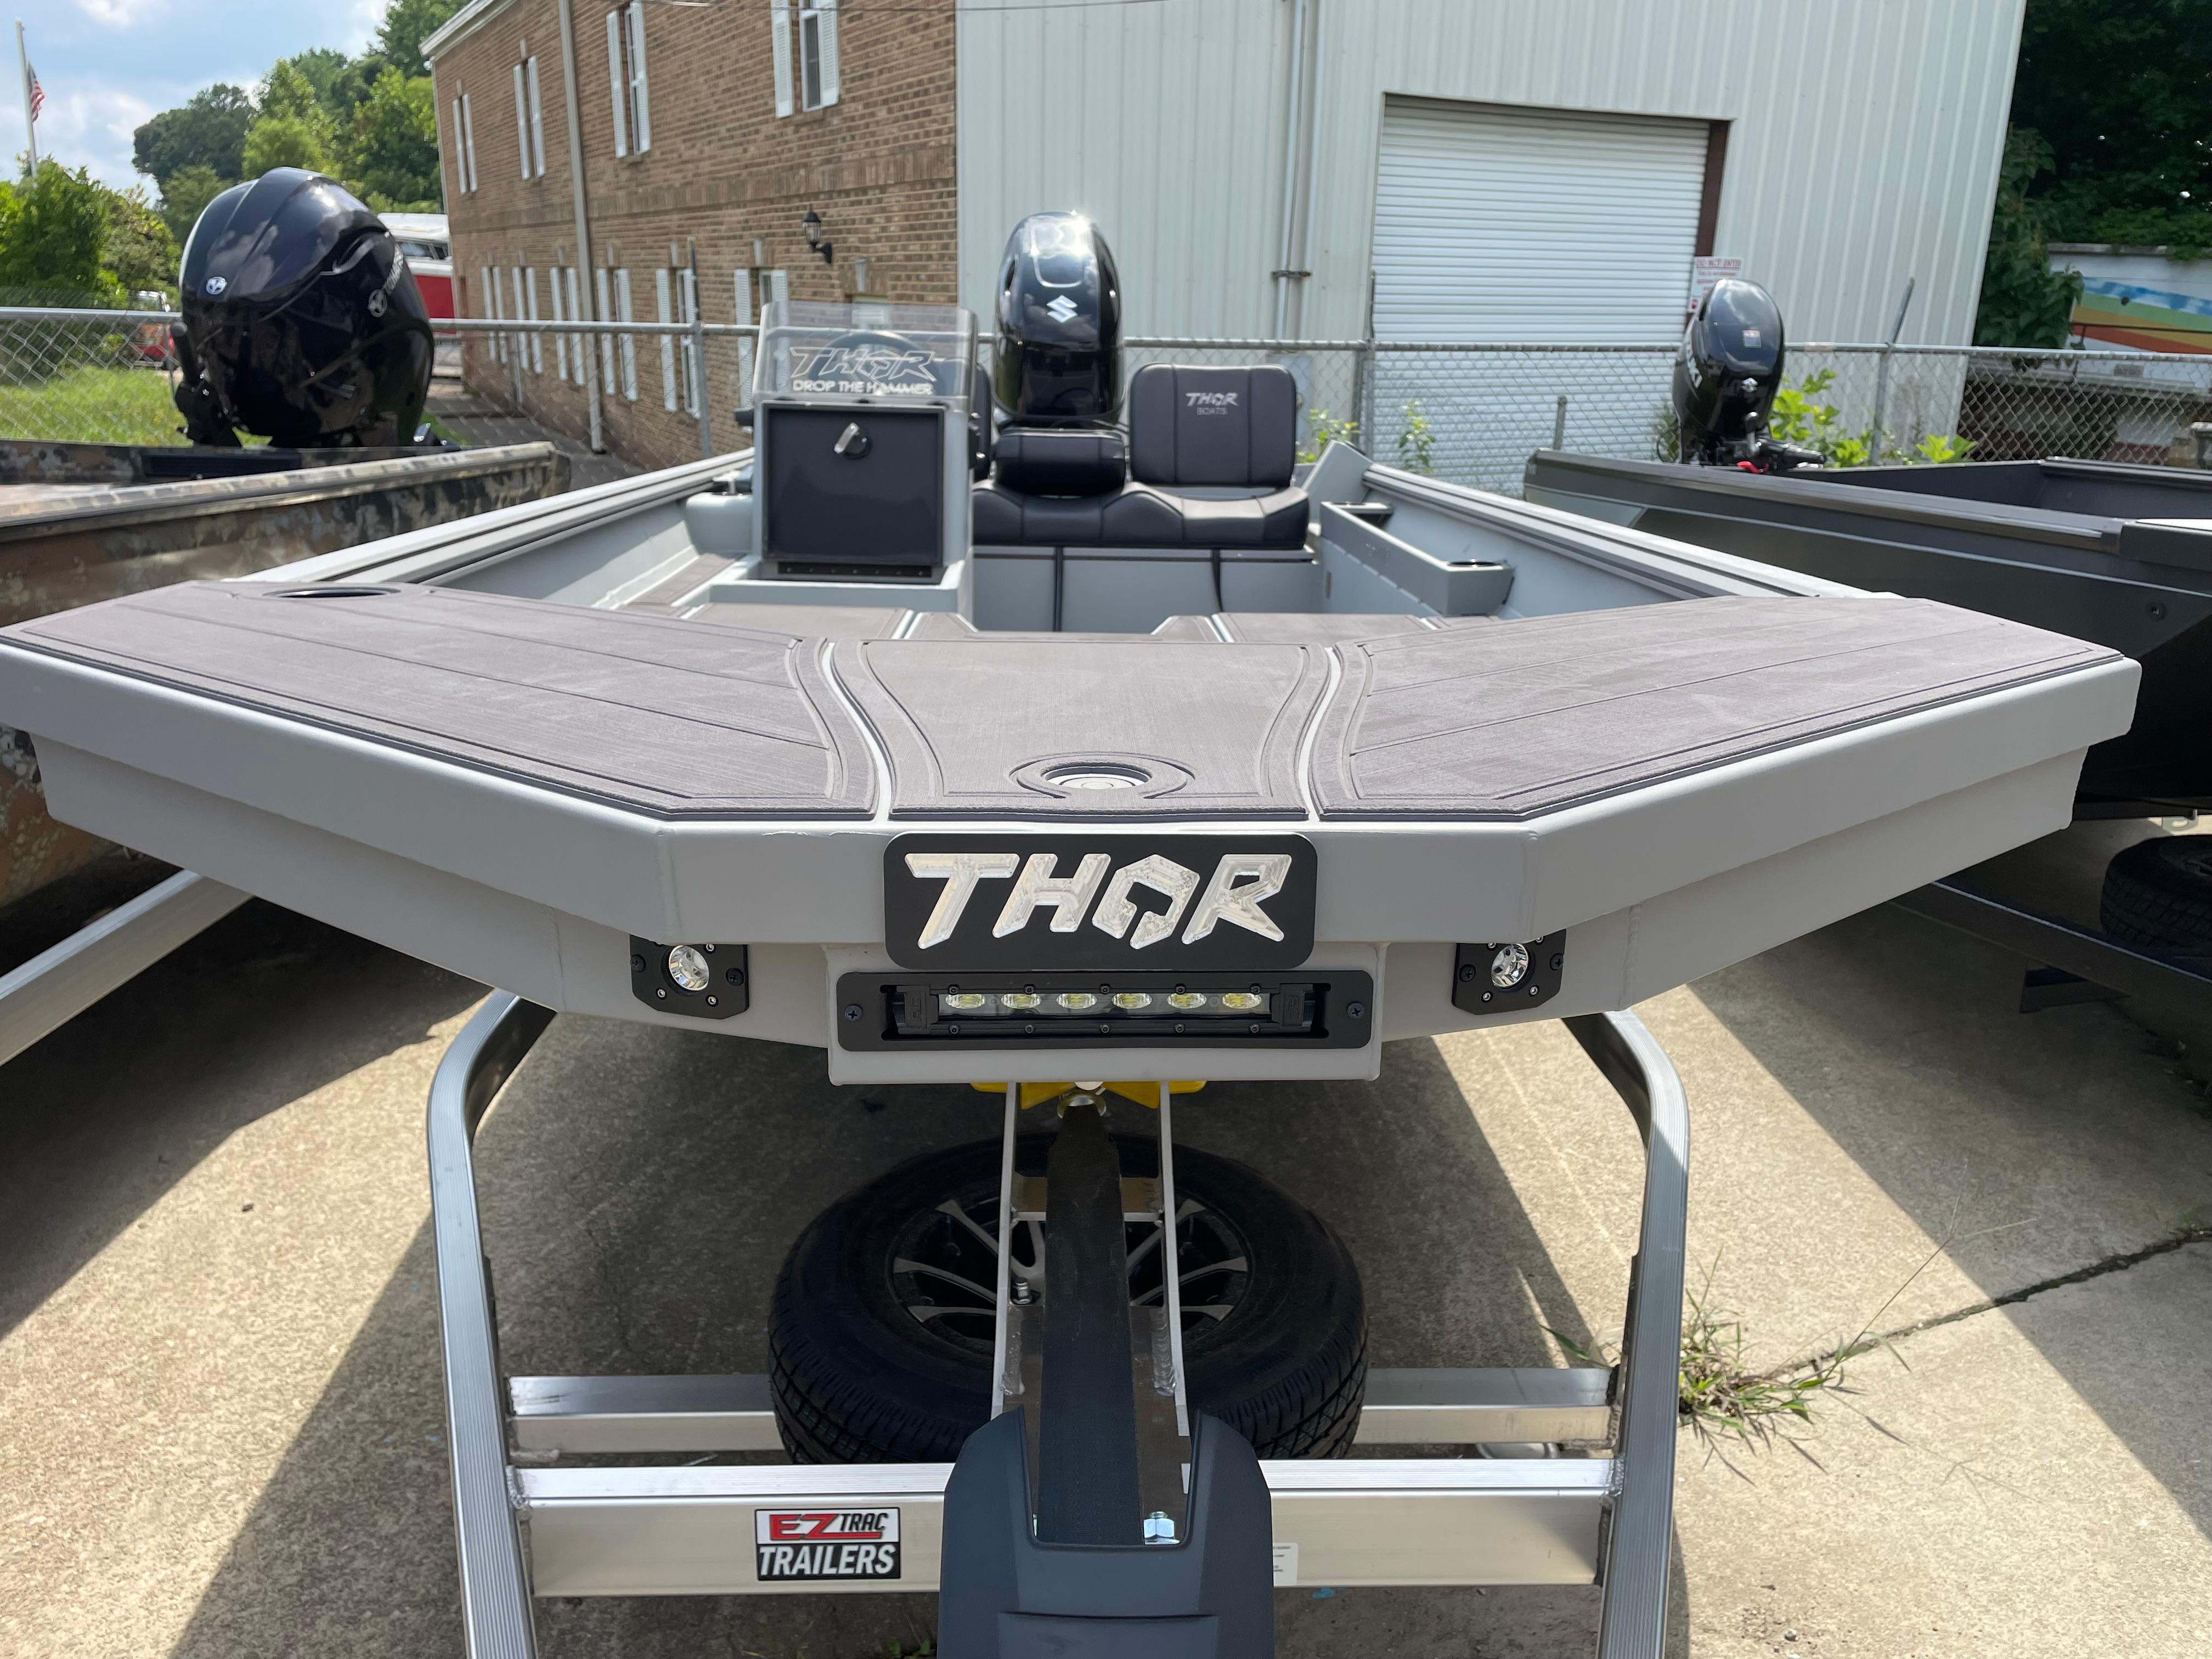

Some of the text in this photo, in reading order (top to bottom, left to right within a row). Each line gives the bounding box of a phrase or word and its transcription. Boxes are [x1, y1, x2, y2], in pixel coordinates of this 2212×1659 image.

[789, 346, 937, 382] THOR
[792, 379, 836, 393] DROP
[838, 380, 865, 393] THE
[1185, 392, 1239, 407] THOR
[1197, 407, 1228, 415] BOATS
[905, 853, 1292, 950] THOR
[770, 1513, 889, 1541] EZ TRAC
[759, 1544, 897, 1576] TRAILERS
